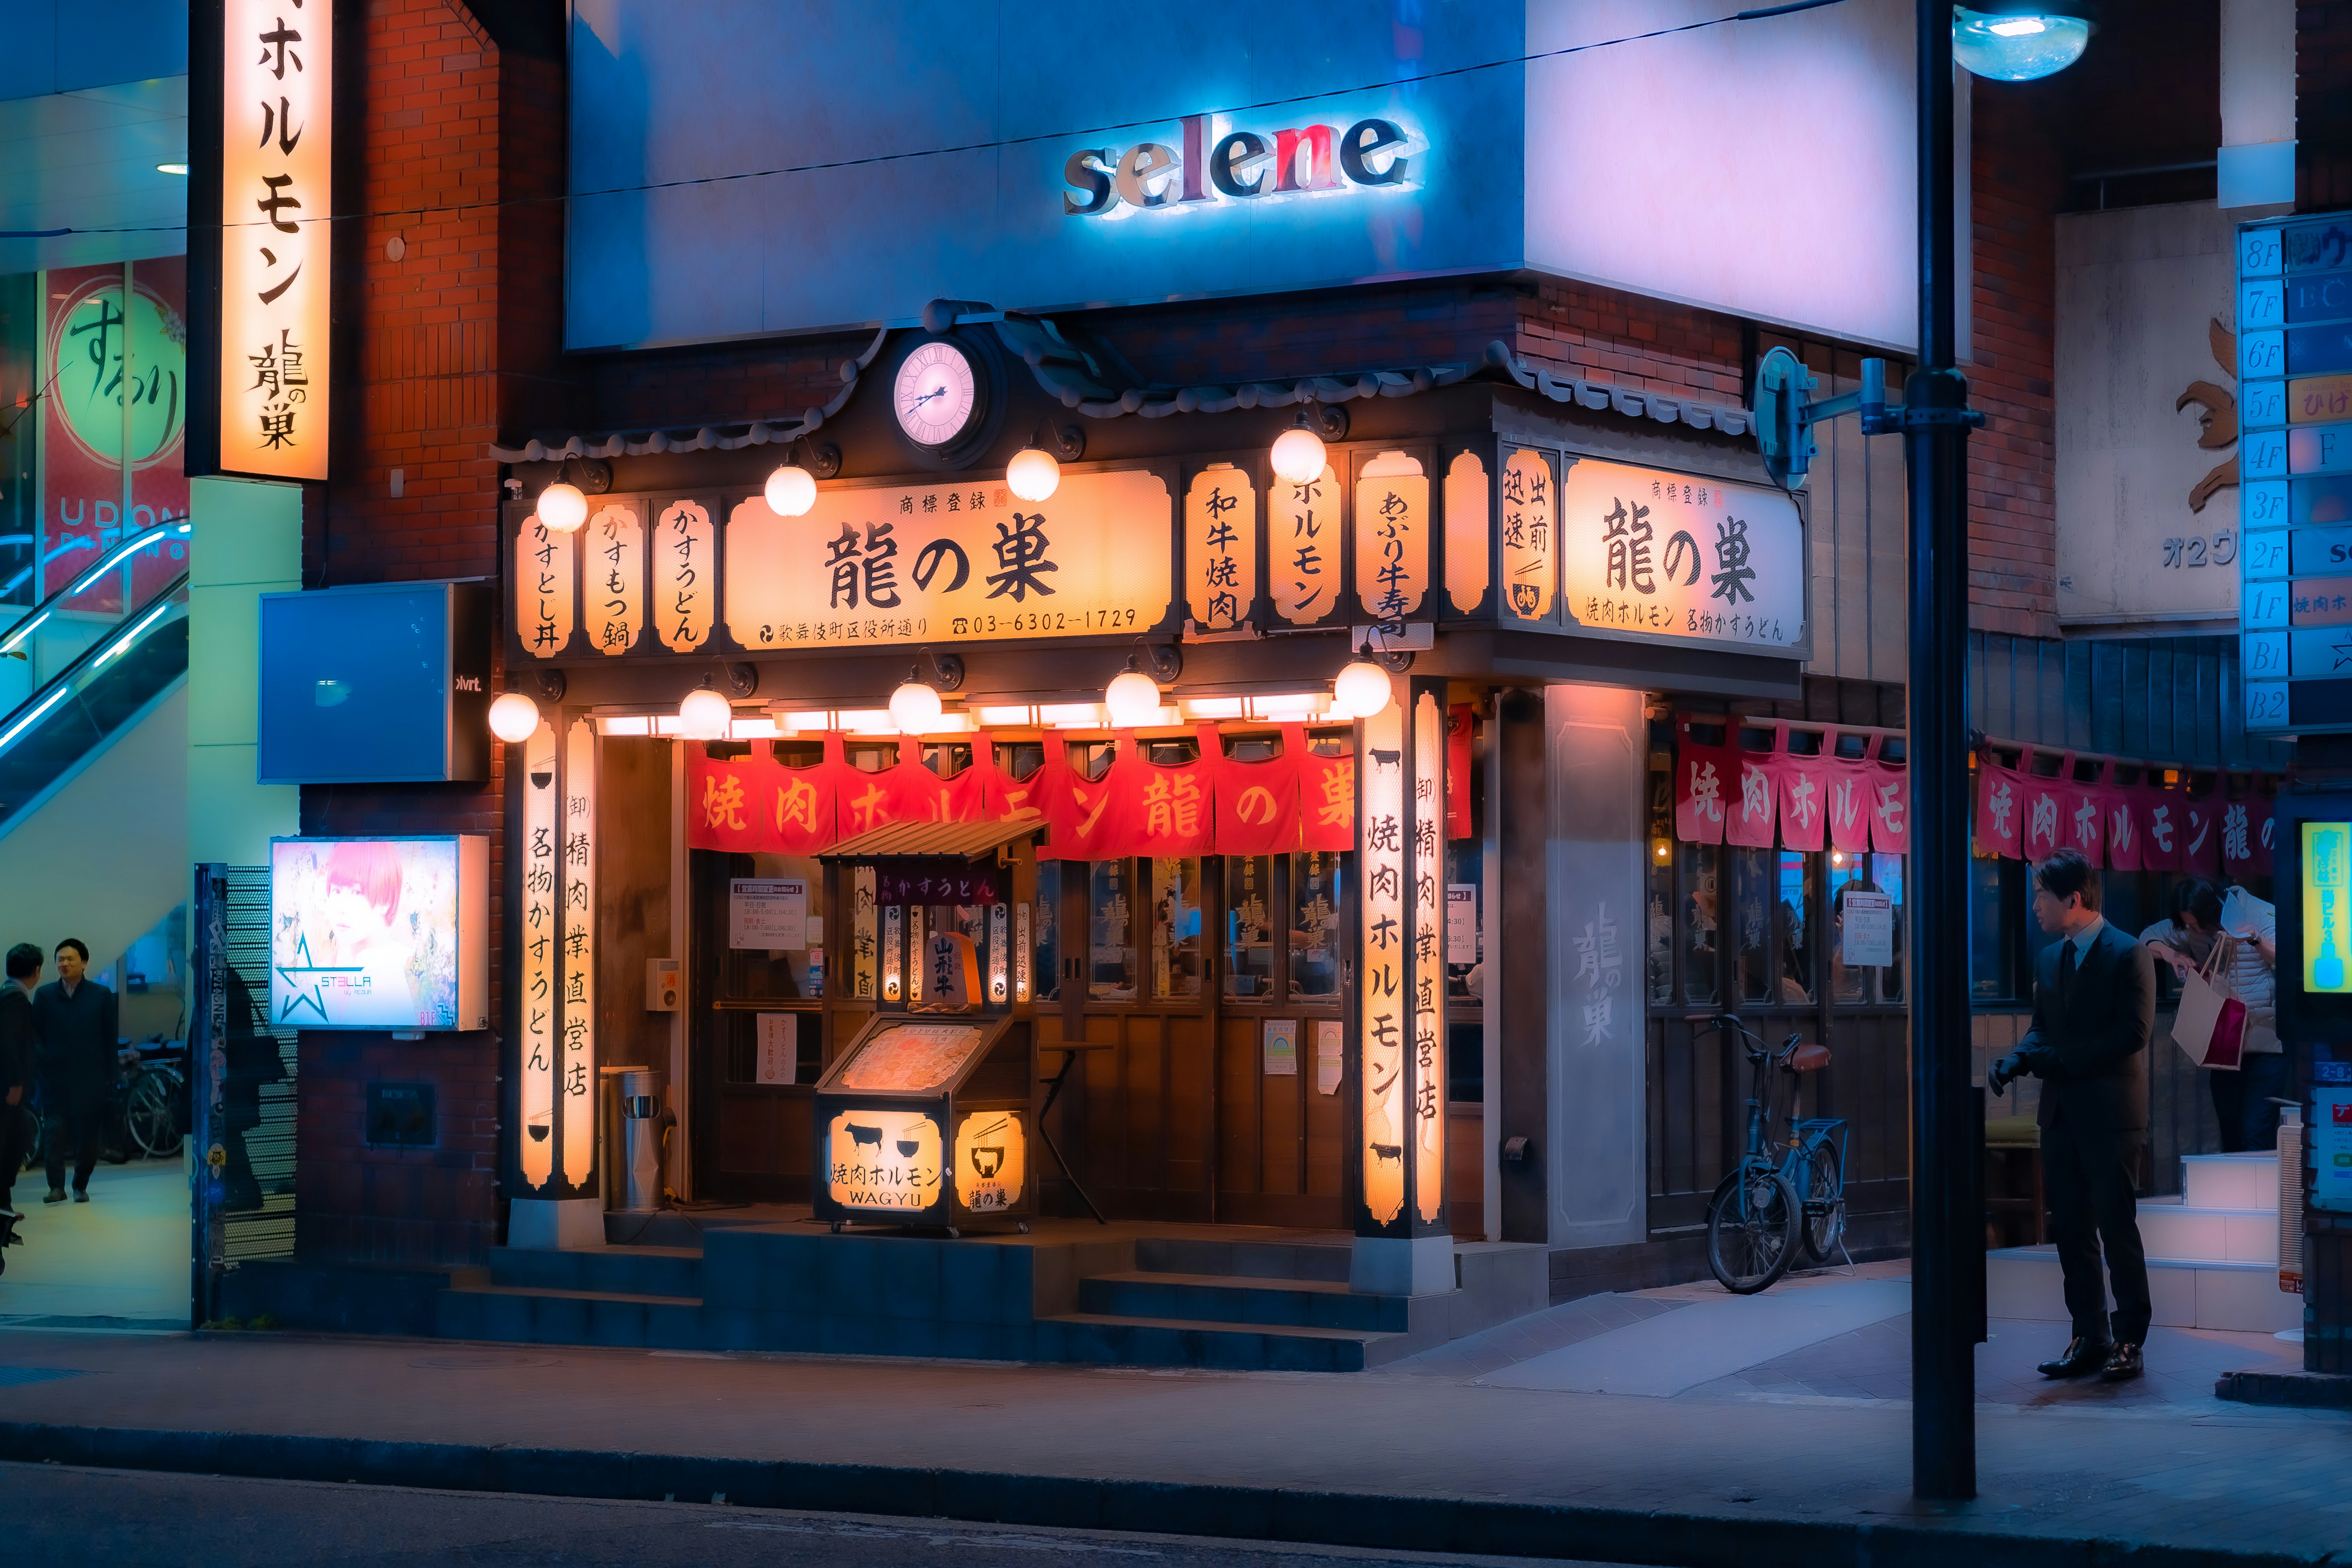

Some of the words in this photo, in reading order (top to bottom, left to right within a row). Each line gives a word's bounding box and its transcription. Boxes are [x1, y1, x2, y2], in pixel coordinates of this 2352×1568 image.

[257, 0, 305, 306] ホルモン
[1063, 114, 1411, 216] selene
[2247, 240, 2279, 268] 8F
[2249, 290, 2278, 318] 7F
[2249, 340, 2280, 368] 6F
[241, 328, 309, 451] 龍の巣
[2250, 390, 2280, 418] 5F
[2250, 441, 2283, 469] 4F
[899, 491, 986, 515] 商標登録
[1504, 469, 1525, 550] 迅速
[1529, 471, 1546, 553] 出前
[1651, 479, 1709, 507] 商標登録
[2253, 492, 2284, 519] 3F
[824, 512, 1059, 611] 龍の巣
[1205, 486, 1240, 623] 和牛焼肉
[1376, 491, 1410, 639] あぶり牛寿司
[1602, 496, 1757, 606] 龍の巣
[2250, 542, 2283, 570] 2F
[602, 515, 630, 648] かすもつ鍋
[672, 510, 699, 643] かすうどん
[1585, 595, 1676, 628] 焼肉ホルモン
[1686, 608, 1784, 642] 名物かすうどん
[2252, 590, 2282, 619] 1F
[2294, 594, 2352, 613] 焼肉ホ
[779, 617, 928, 643] 歌舞伎町区役所通り
[973, 608, 1136, 634] 03-6302-1729
[2252, 642, 2280, 670] B1
[2249, 691, 2285, 719] B2
[1690, 761, 1904, 834] 焼肉ホルモ
[527, 826, 553, 1072] 名物かすうどん
[933, 937, 954, 998] 山形牛
[1368, 814, 1401, 1096] 焼肉ホルモン
[1571, 900, 1623, 1051] 龍の巣
[831, 1163, 942, 1187] 焼肉ホルモン
[849, 1190, 921, 1207] WAGYU
[968, 1189, 1007, 1209] 龍の巣
